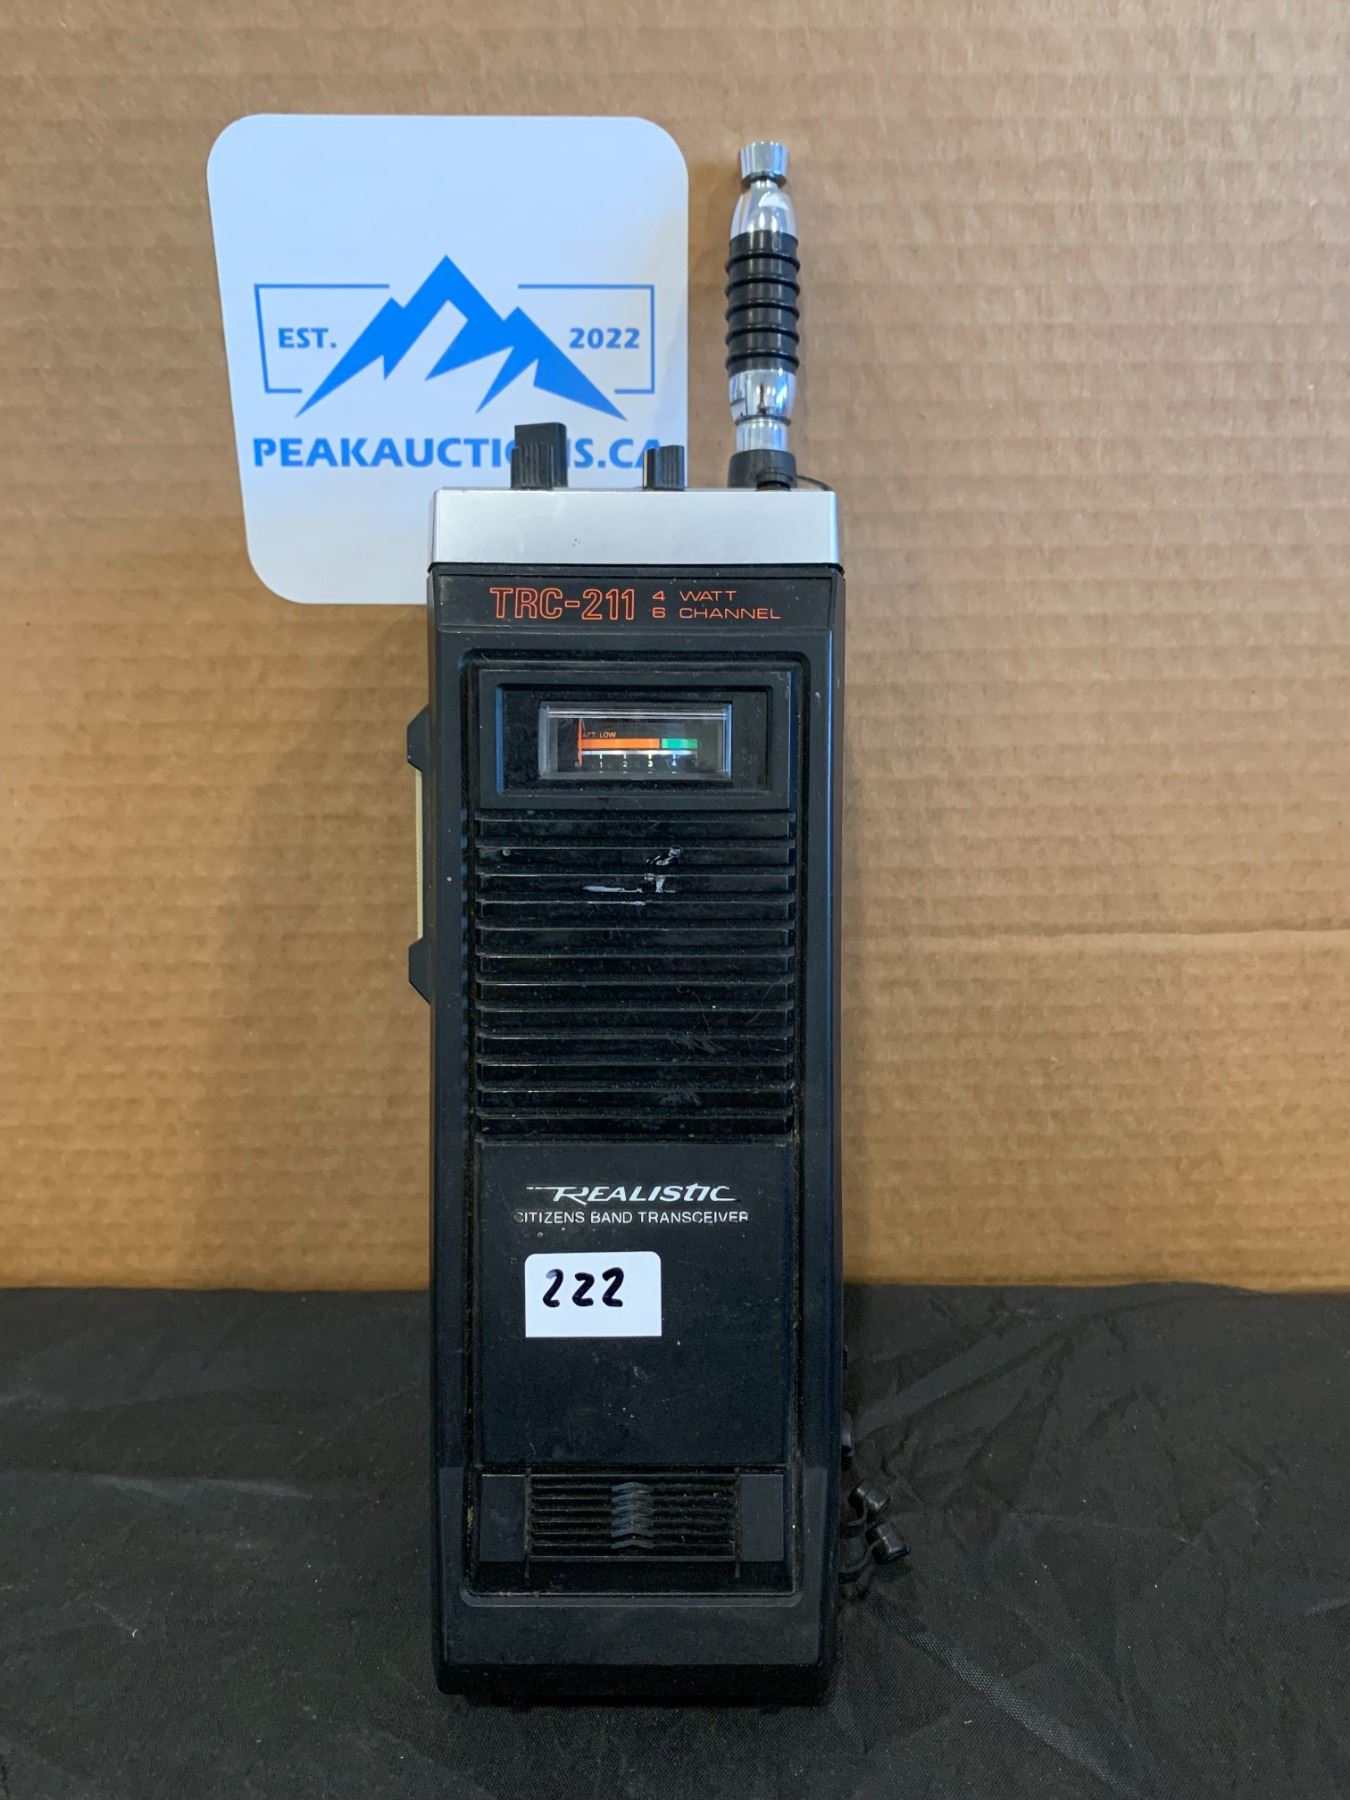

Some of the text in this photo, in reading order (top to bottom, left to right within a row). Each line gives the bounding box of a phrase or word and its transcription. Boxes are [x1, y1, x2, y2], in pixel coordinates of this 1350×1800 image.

[278, 328, 337, 349] EST.
[568, 328, 640, 349] 2022
[651, 590, 737, 602] 4 WATT
[489, 587, 635, 621] TRC-211
[651, 607, 782, 620] 6 CHANNEL
[599, 731, 617, 739] LOW
[622, 760, 628, 768] 2
[647, 760, 653, 768] 3
[671, 760, 677, 768] 4
[514, 1211, 749, 1224] CITIZENS BAND TRANSCEIVER
[542, 1267, 625, 1308] 222
